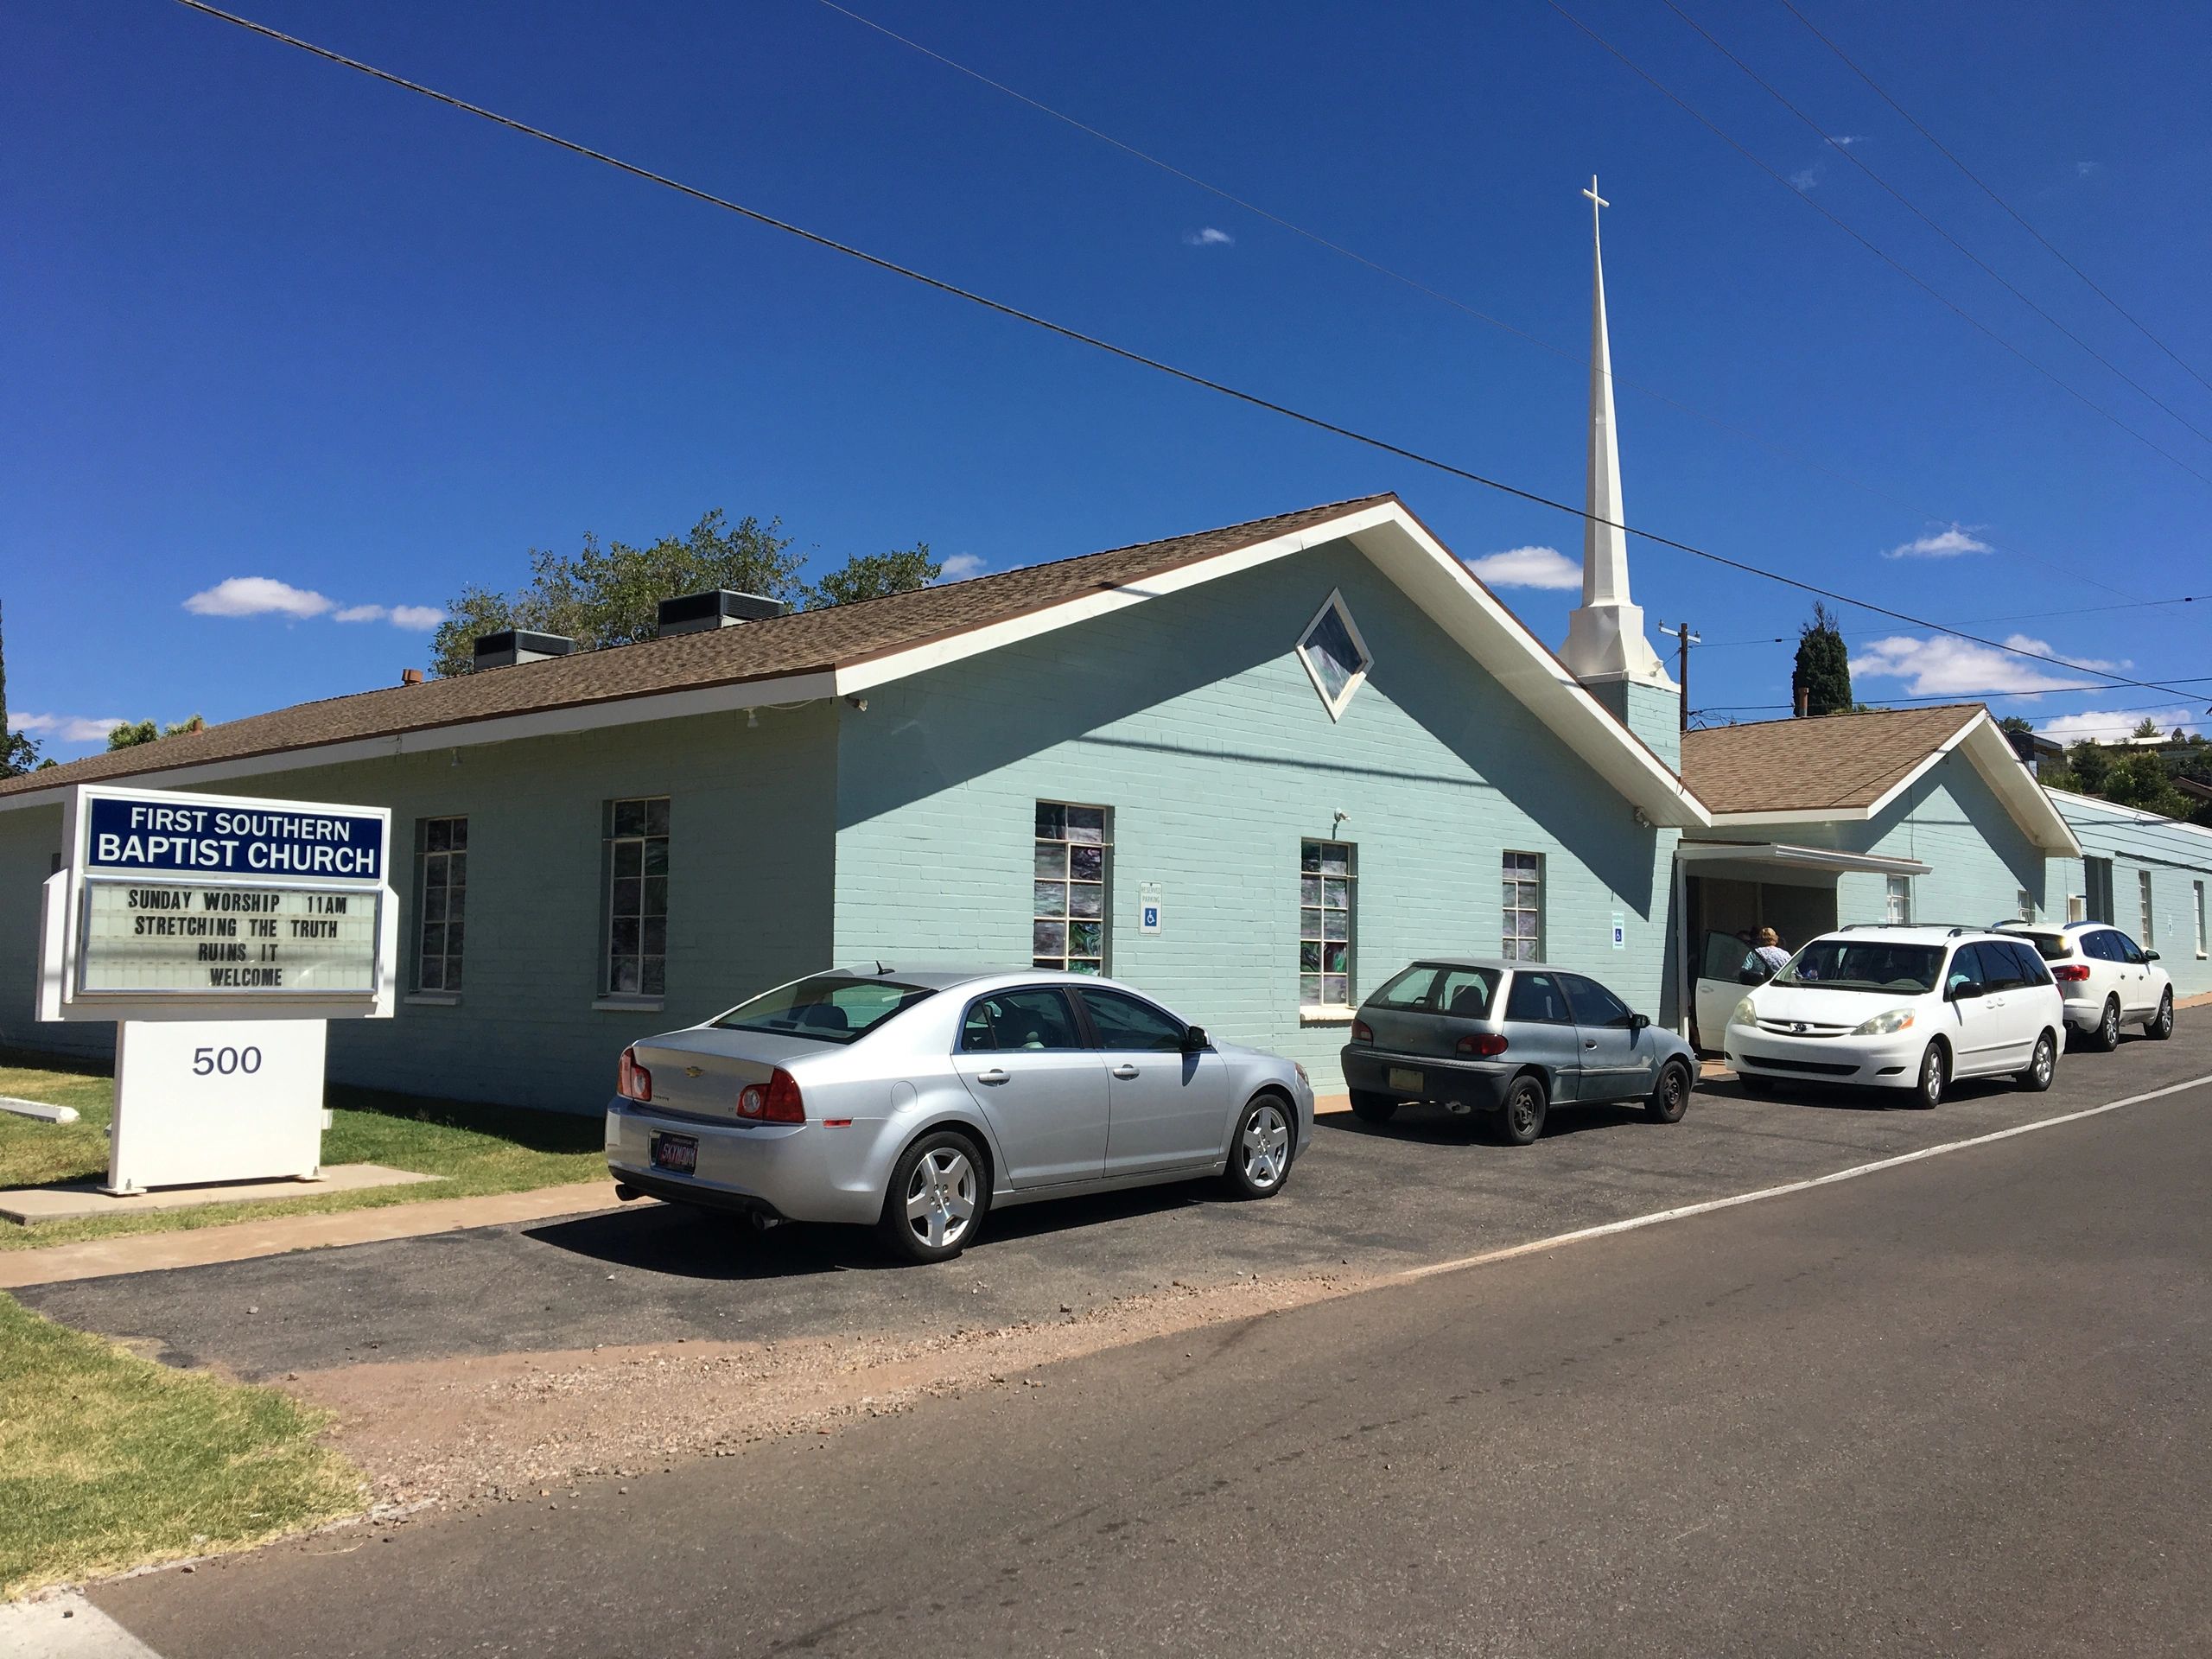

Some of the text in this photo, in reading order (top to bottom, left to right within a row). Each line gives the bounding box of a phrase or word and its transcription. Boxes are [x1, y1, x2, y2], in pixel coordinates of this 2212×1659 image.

[130, 806, 350, 842] FIRST SOUTHERN
[98, 833, 374, 874] BAPTIST CHURCH
[128, 889, 347, 914] SUNDAY WORSHIP 11AM
[1141, 895, 1160, 904] PARKING
[134, 915, 338, 938] STRETCHING THE TRUTH
[198, 943, 278, 962] RUINS IT
[210, 968, 283, 987] WELCOME
[192, 1046, 262, 1076] 500
